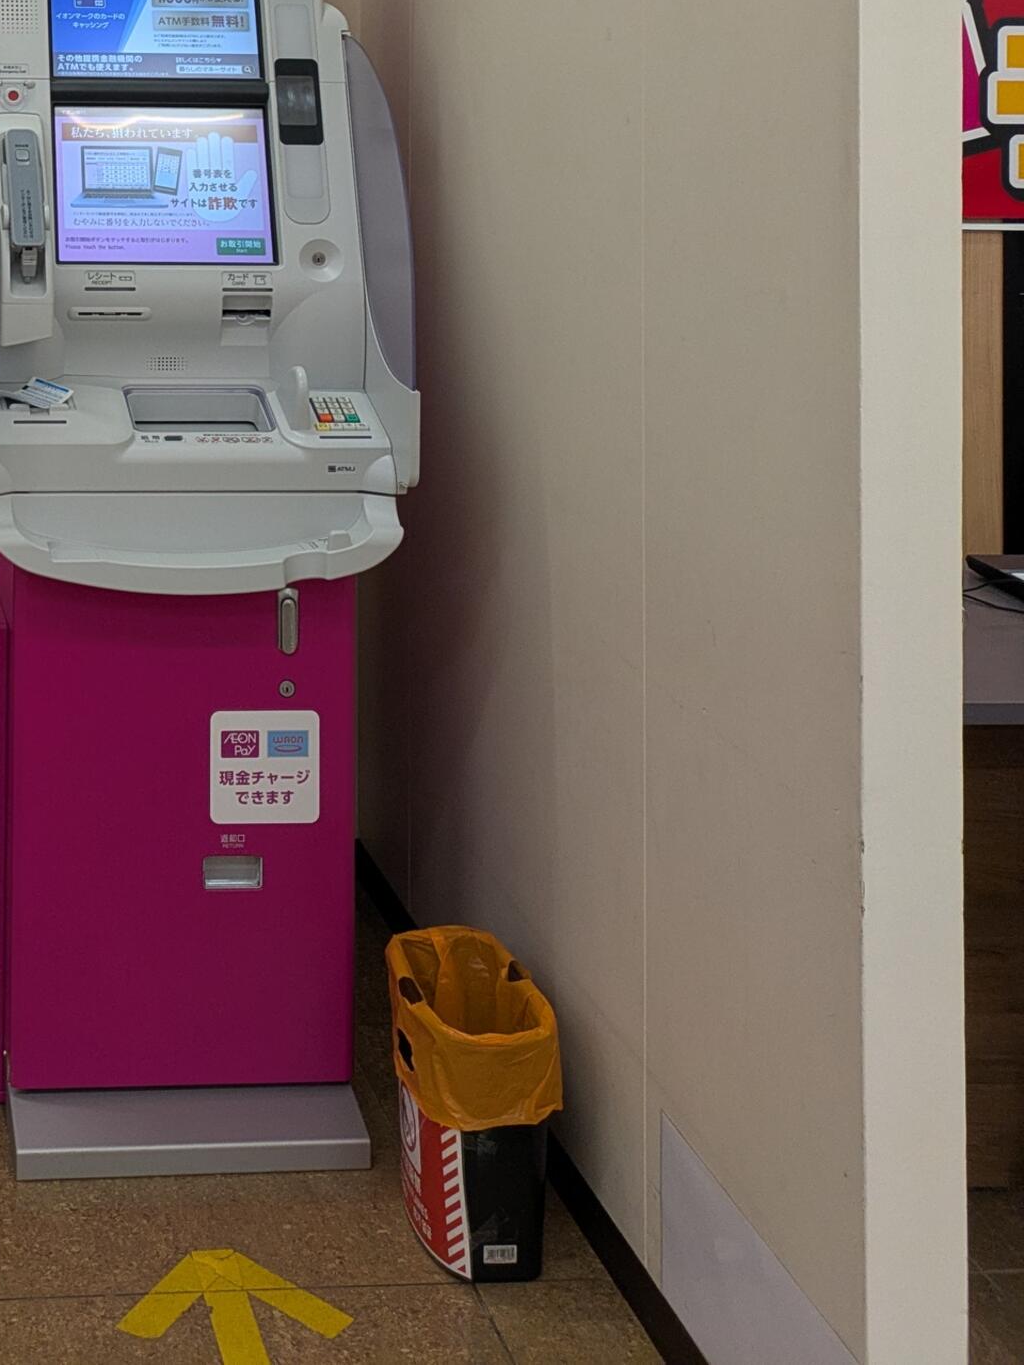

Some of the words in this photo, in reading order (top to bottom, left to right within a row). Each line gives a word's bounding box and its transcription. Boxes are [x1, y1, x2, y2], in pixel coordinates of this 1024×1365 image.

[191, 168, 233, 179] 番号表を
[189, 183, 238, 193] 入力させる
[170, 196, 258, 211] サイトは詐欺です
[87, 272, 116, 280] レシート
[227, 273, 249, 281] カード
[234, 744, 256, 757] Pay
[219, 769, 311, 785] 現金チャージ
[235, 790, 295, 805] できます
